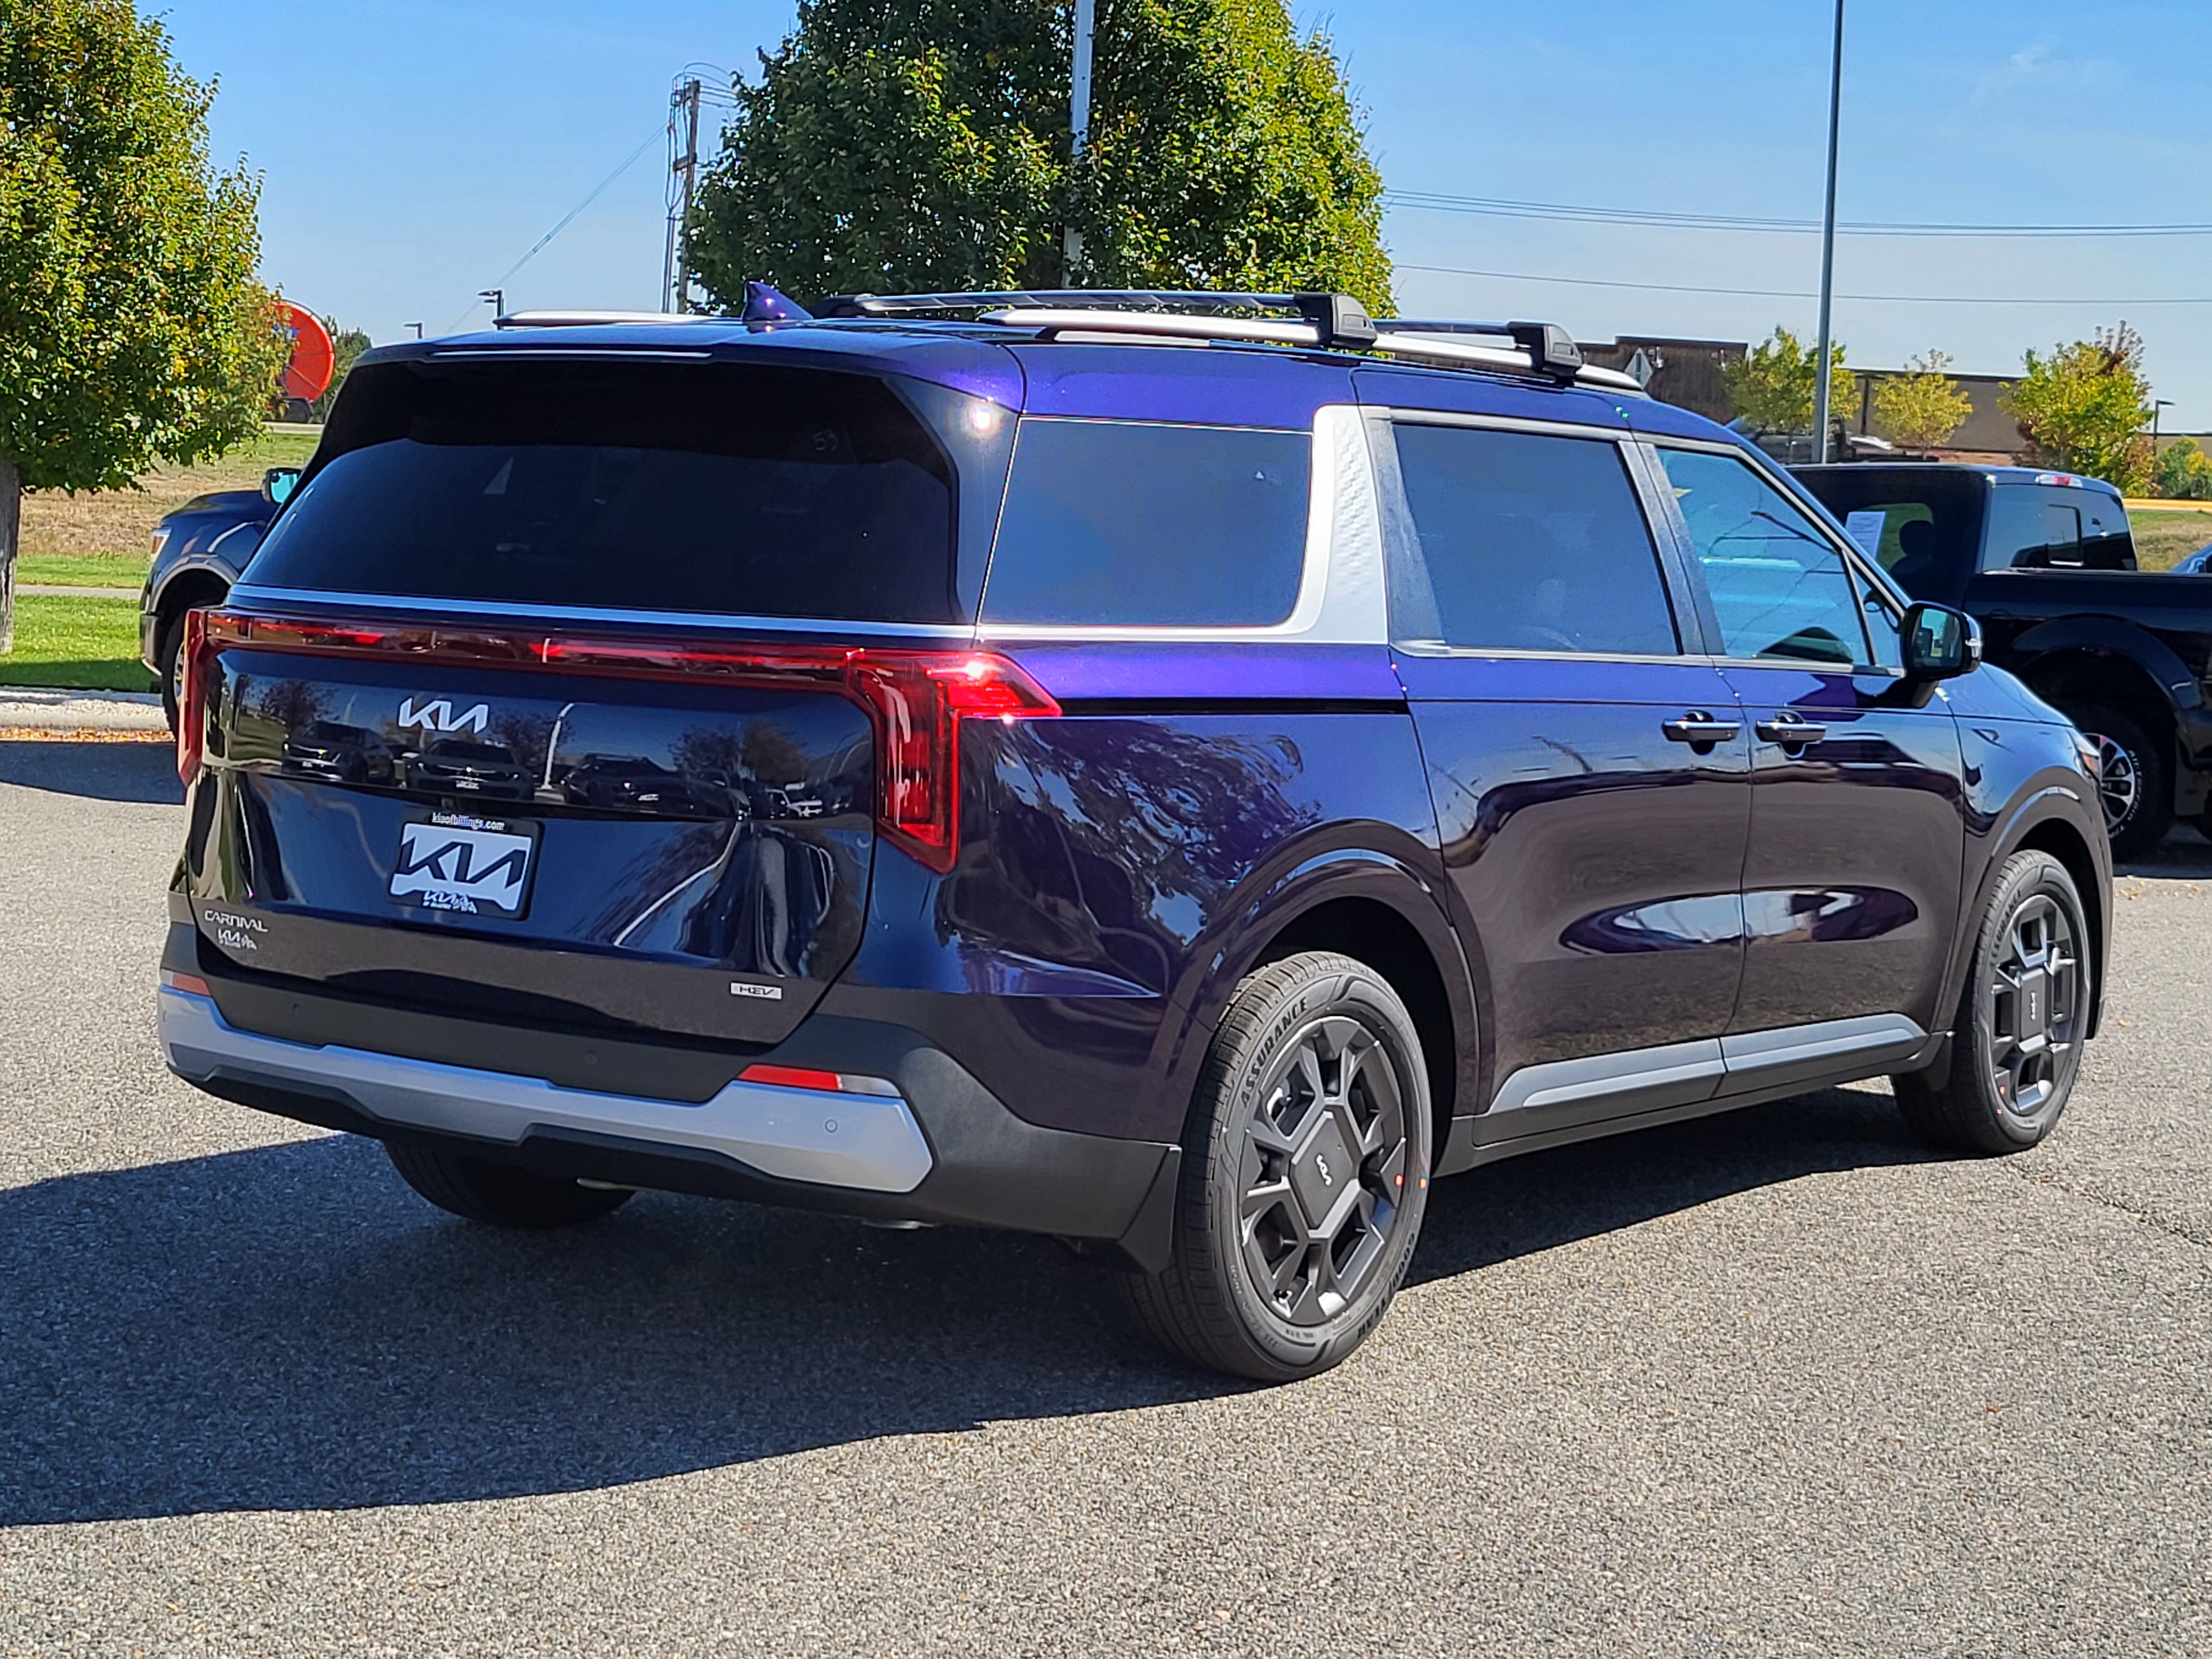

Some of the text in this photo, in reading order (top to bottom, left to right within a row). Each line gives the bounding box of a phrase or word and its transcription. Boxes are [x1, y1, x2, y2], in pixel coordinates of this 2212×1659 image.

[398, 697, 489, 734] KIA
[396, 836, 527, 889] KIA
[204, 910, 269, 933] CARNIVAL
[739, 985, 775, 996] HEV
[1241, 996, 1308, 1109] ASSURANCE
